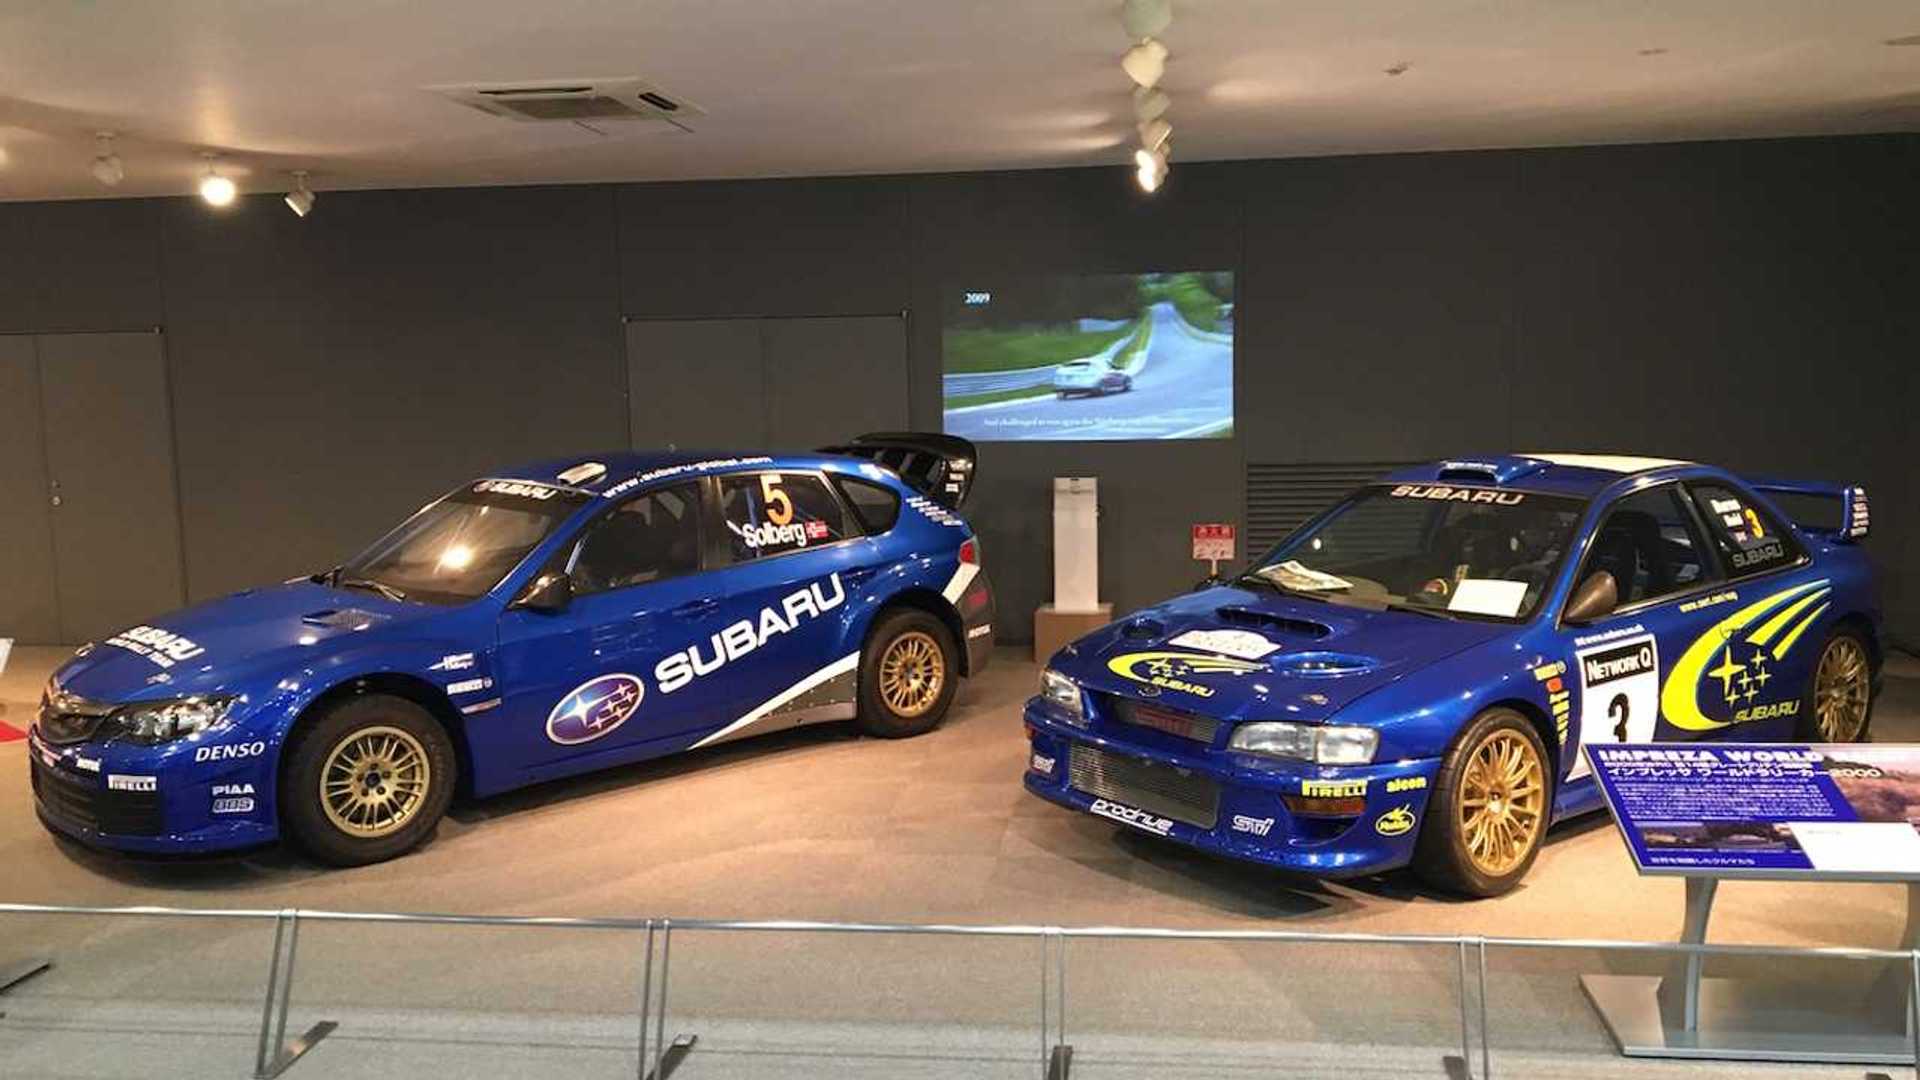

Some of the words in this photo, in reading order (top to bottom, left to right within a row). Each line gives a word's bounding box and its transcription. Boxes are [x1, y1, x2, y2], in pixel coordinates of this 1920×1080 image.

[964, 292, 991, 304] 2009
[761, 473, 793, 525] 5
[1391, 485, 1525, 505] SUBARU
[1744, 508, 1764, 539] 3
[742, 521, 807, 548] Solberg
[1732, 544, 1784, 568] SUBARU
[119, 625, 205, 660] SUBARU
[654, 572, 845, 694] SUBARU
[1640, 647, 1652, 668] Q
[1151, 676, 1215, 697] SUBARU
[1607, 692, 1630, 743] 3
[1735, 700, 1800, 722] SUBARU
[195, 741, 265, 762] DENSO
[1723, 750, 1824, 763] WORLD
[107, 774, 158, 792] PIRELLI
[212, 784, 255, 796] PIAA
[1302, 780, 1368, 797] PIRELLI
